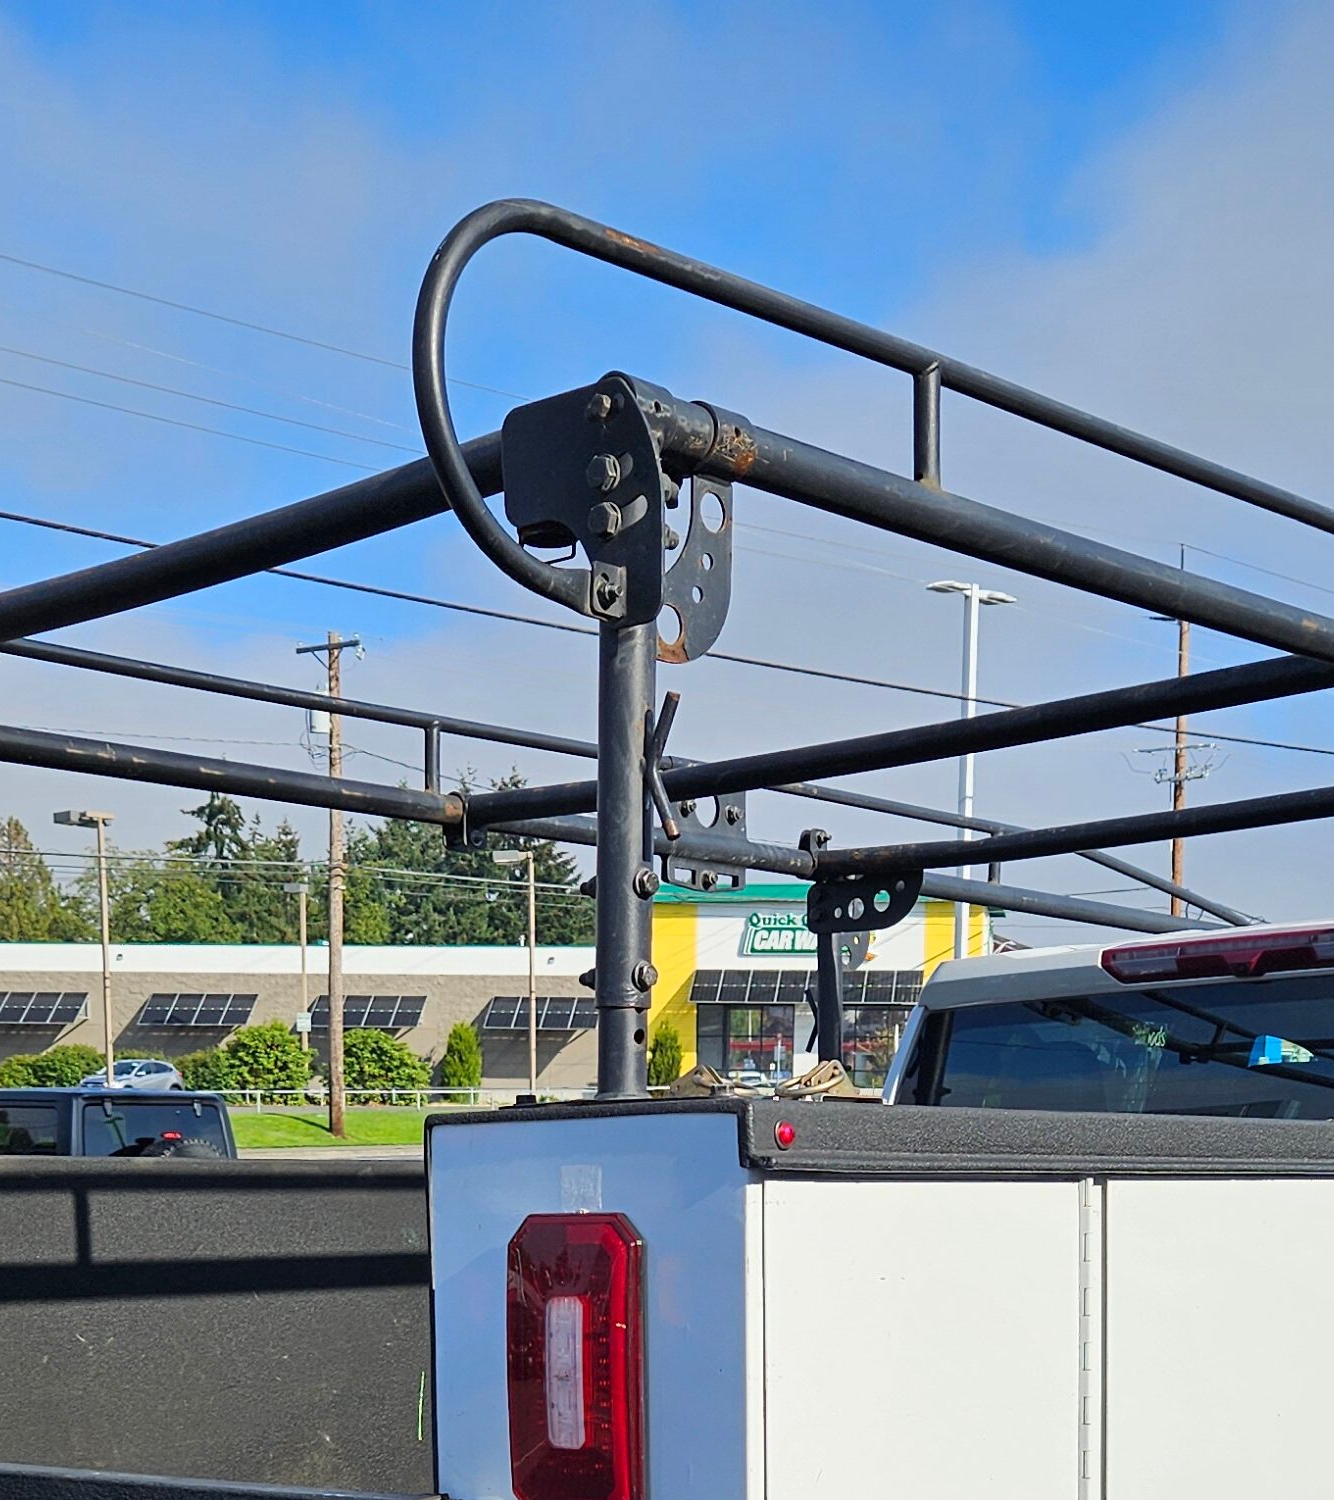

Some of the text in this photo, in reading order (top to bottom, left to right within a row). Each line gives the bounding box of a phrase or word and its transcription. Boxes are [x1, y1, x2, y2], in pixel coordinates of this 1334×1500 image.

[749, 912, 798, 927] Quick
[752, 929, 818, 951] CAR WA
